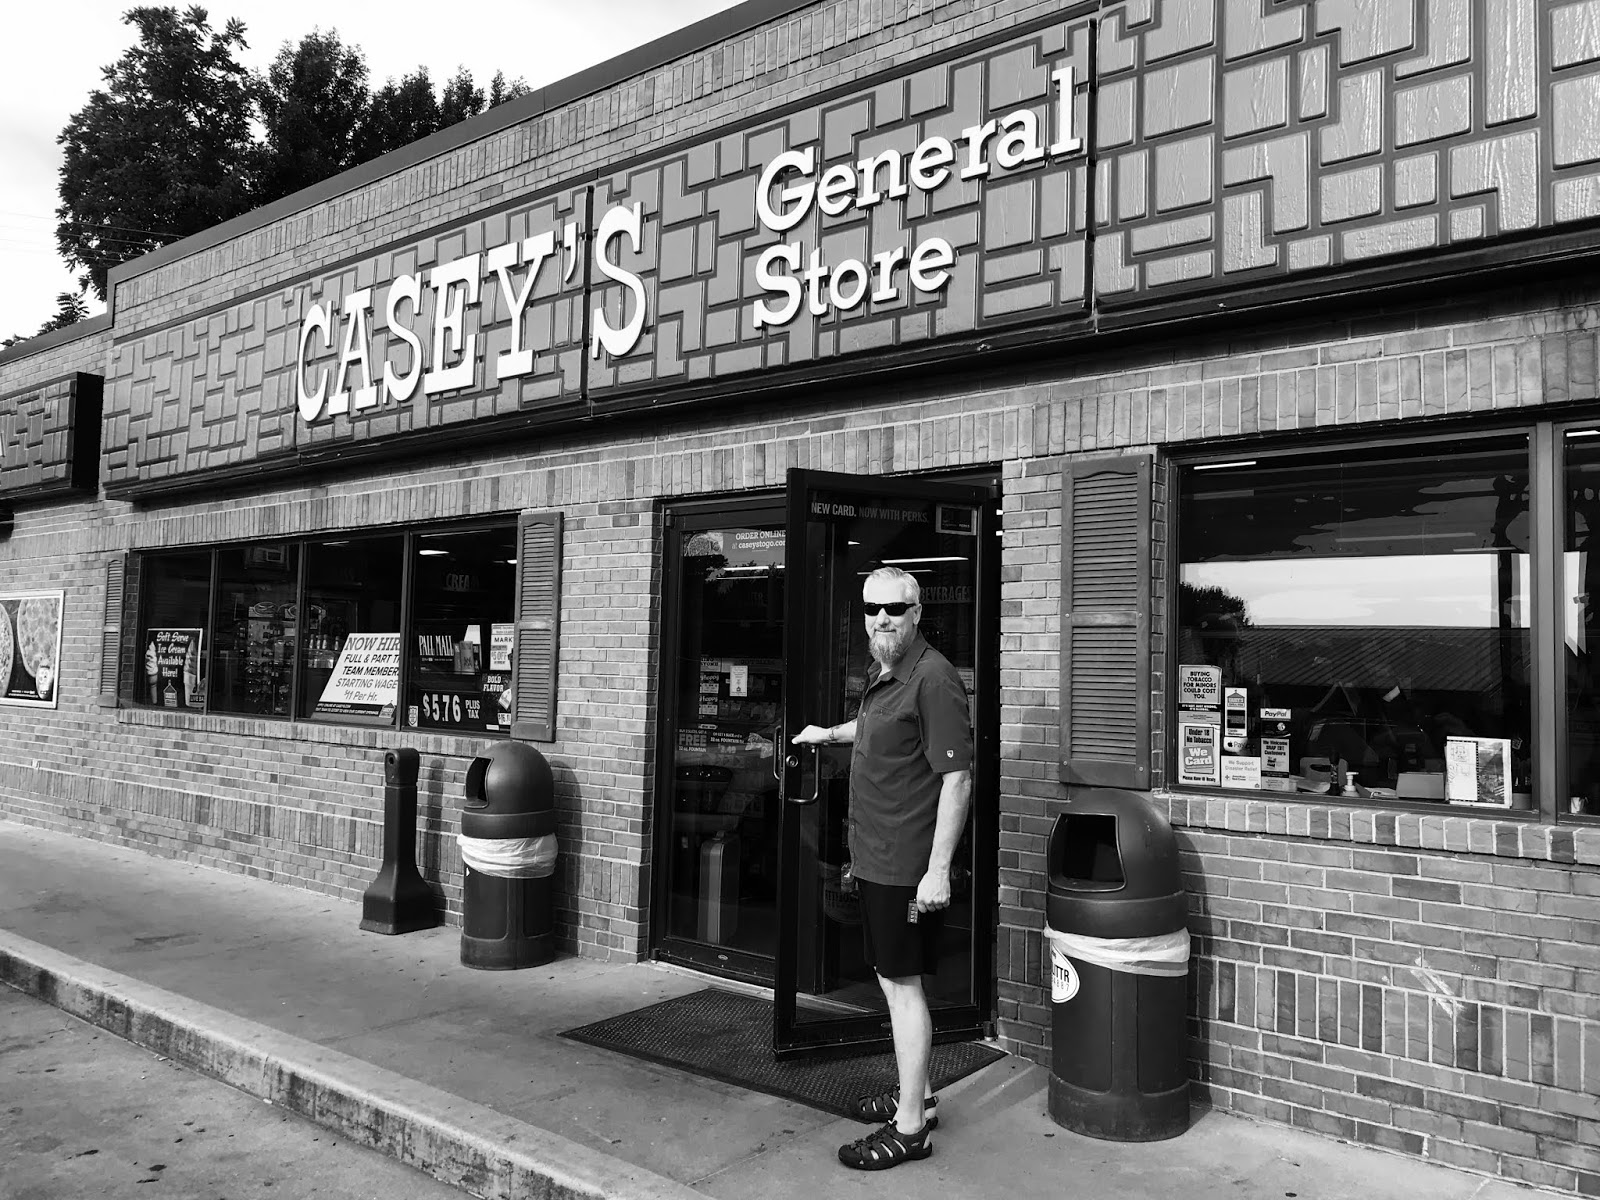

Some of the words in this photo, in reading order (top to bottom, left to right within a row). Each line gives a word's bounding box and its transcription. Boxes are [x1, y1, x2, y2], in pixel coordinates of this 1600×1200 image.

[756, 66, 1082, 231] General
[754, 237, 953, 329] Store
[298, 201, 646, 421] CASEY'S
[811, 501, 831, 514] NEW
[832, 503, 857, 517] CARD.
[858, 505, 877, 518] NOW
[878, 507, 900, 520] WITH
[735, 532, 758, 540] ORDER
[760, 530, 786, 539] ONLINE
[156, 631, 171, 642] Soft
[171, 631, 189, 642] Serve
[157, 643, 167, 653] Ice
[168, 643, 186, 653] Cream
[344, 637, 378, 650] NOW
[418, 635, 435, 656] PALL
[435, 635, 455, 656] MALL
[157, 655, 184, 666] Available
[344, 654, 361, 663] FULL
[363, 654, 371, 663] &
[371, 655, 392, 663] PART
[162, 667, 178, 677] Here!
[342, 666, 364, 675] TEAM
[336, 678, 373, 688] STARTING
[487, 675, 502, 684] BOLD
[483, 684, 504, 692] FLAVOR
[353, 692, 366, 700] Per
[465, 700, 480, 709] PLUS
[467, 709, 480, 719] TAX
[1264, 710, 1287, 718] PayPal
[679, 733, 707, 747] FREE
[1233, 741, 1247, 749] Pay
[1188, 747, 1208, 757] We
[1185, 755, 1213, 766] Card
